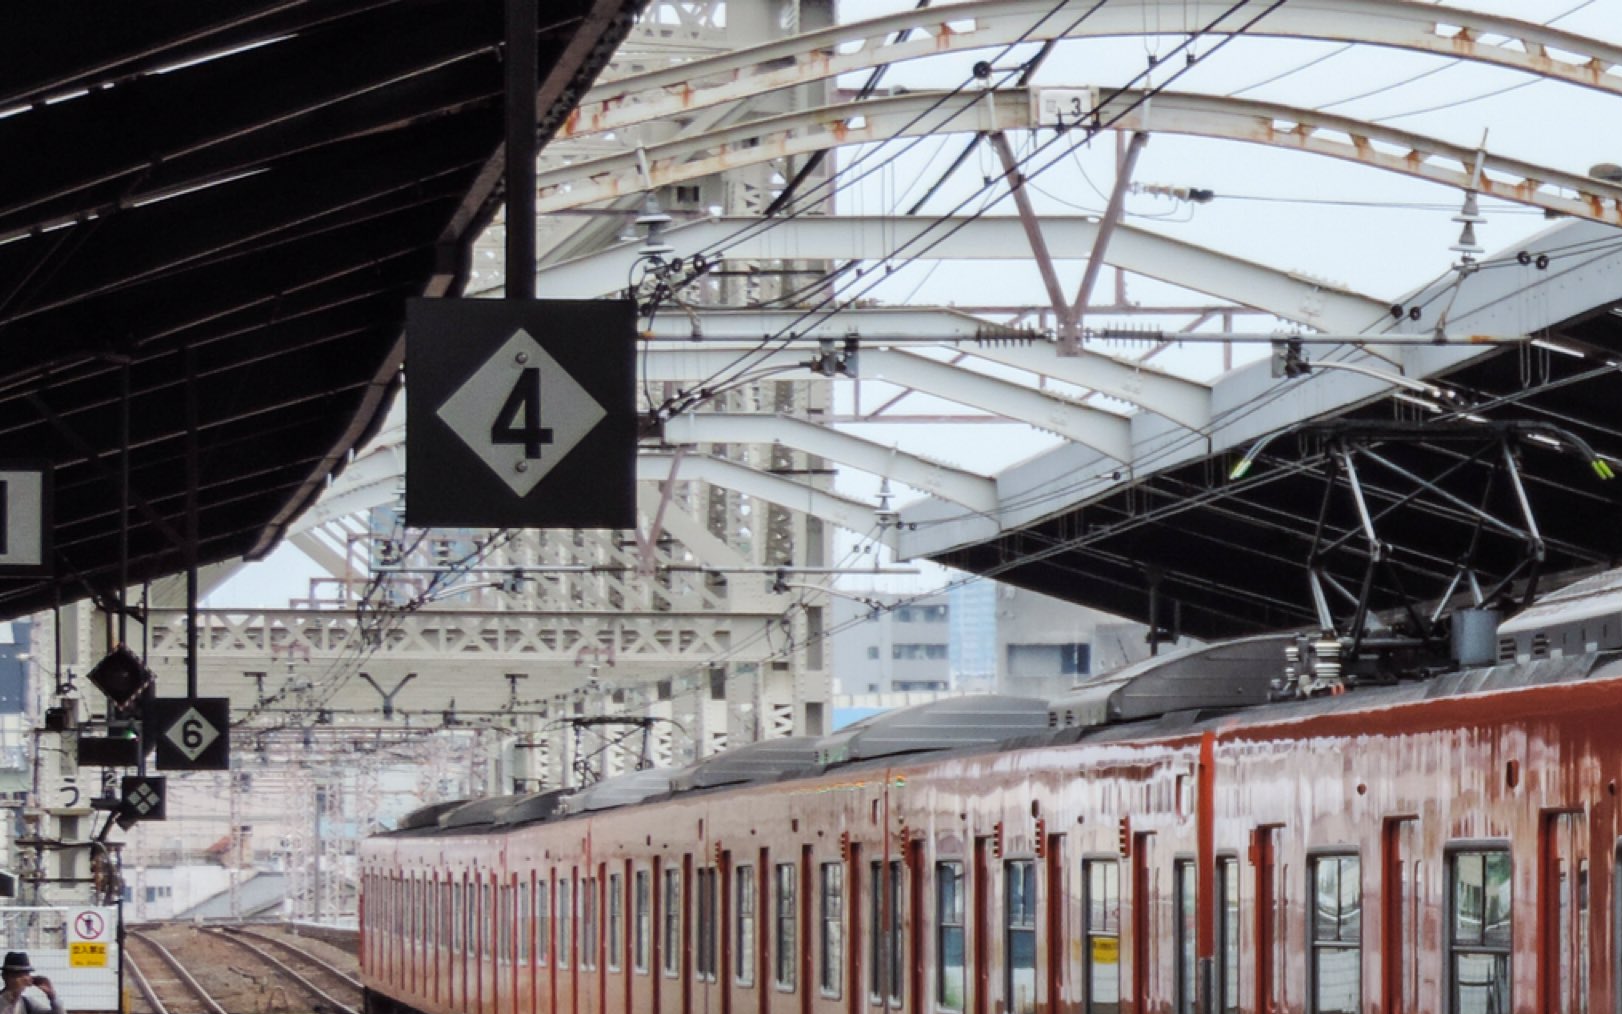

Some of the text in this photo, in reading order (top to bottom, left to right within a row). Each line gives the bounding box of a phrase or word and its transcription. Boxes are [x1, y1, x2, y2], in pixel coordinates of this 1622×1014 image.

[1072, 97, 1081, 117] 3
[491, 367, 553, 460] 4
[181, 718, 204, 749] 6
